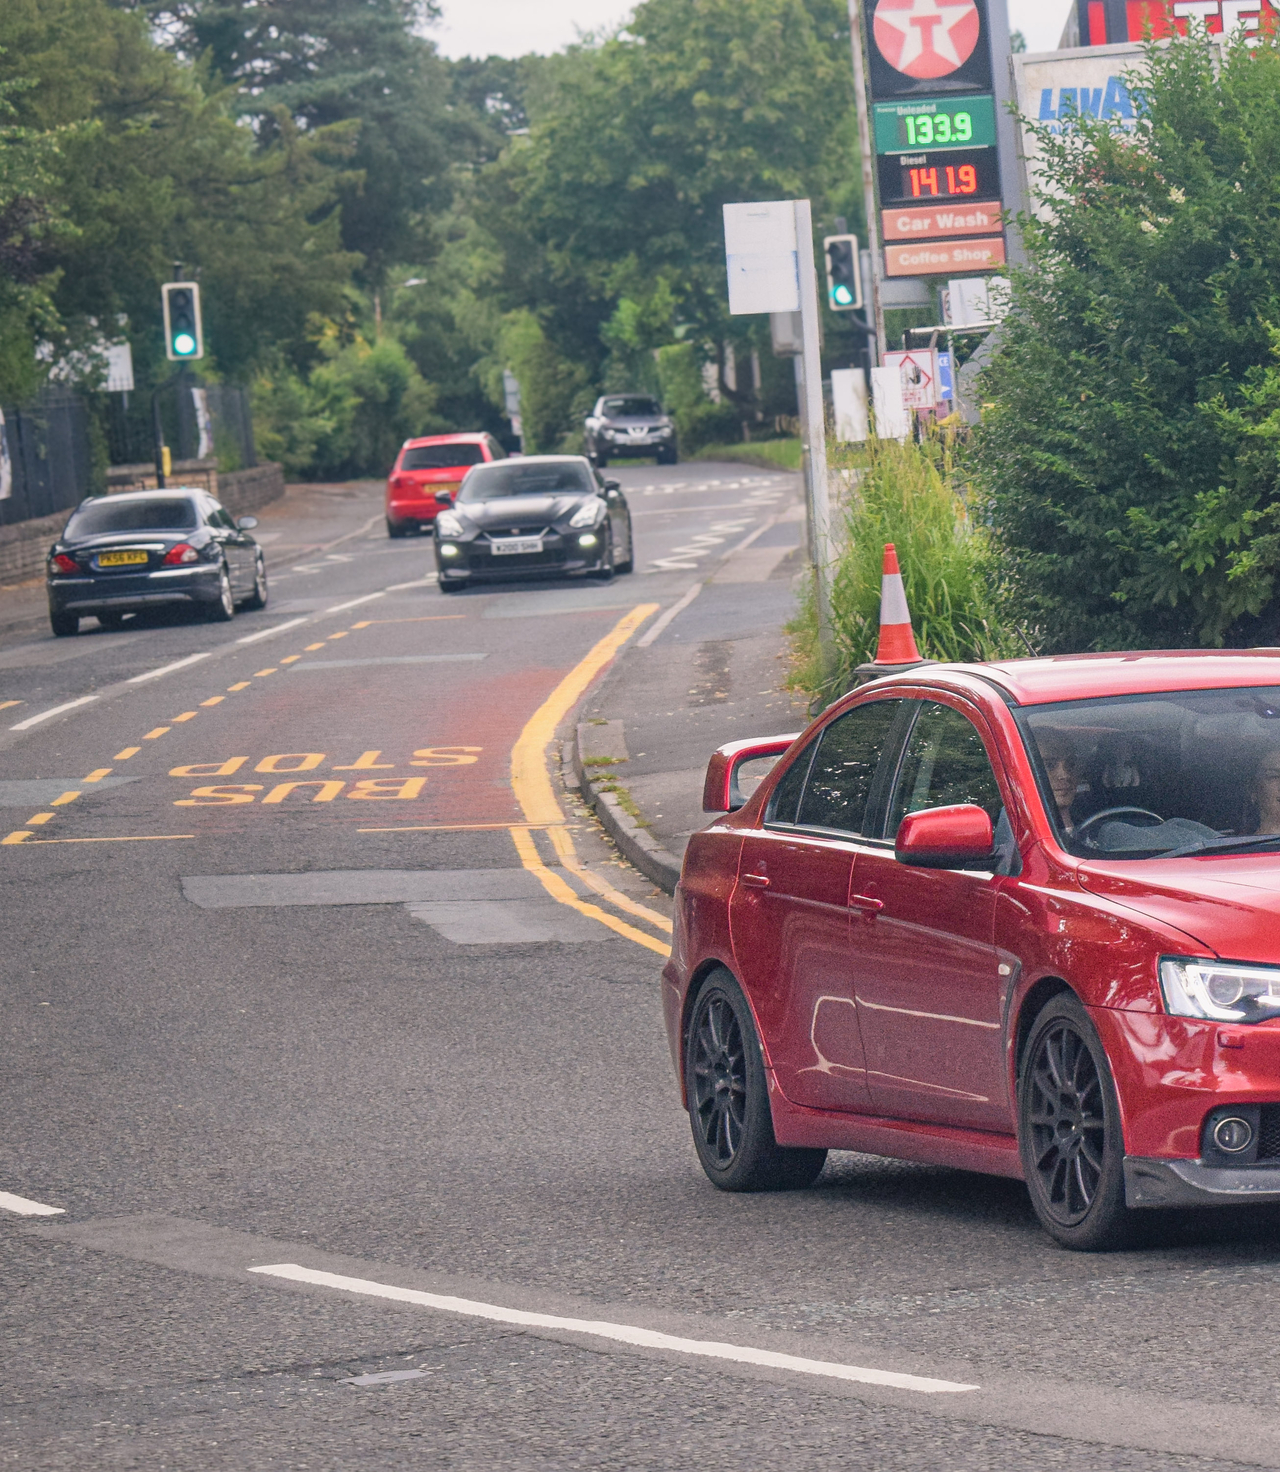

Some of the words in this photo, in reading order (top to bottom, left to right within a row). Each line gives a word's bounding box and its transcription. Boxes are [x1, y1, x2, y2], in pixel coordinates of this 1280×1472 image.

[896, 104, 937, 115] Unleaded
[905, 112, 972, 145] 133.9
[900, 154, 927, 165] Diesel
[897, 216, 931, 232] Car
[936, 211, 988, 229] Wash
[899, 253, 949, 266] Coffee
[952, 249, 991, 263] Shop
[168, 746, 483, 777] STOP
[173, 777, 428, 806] BUS
